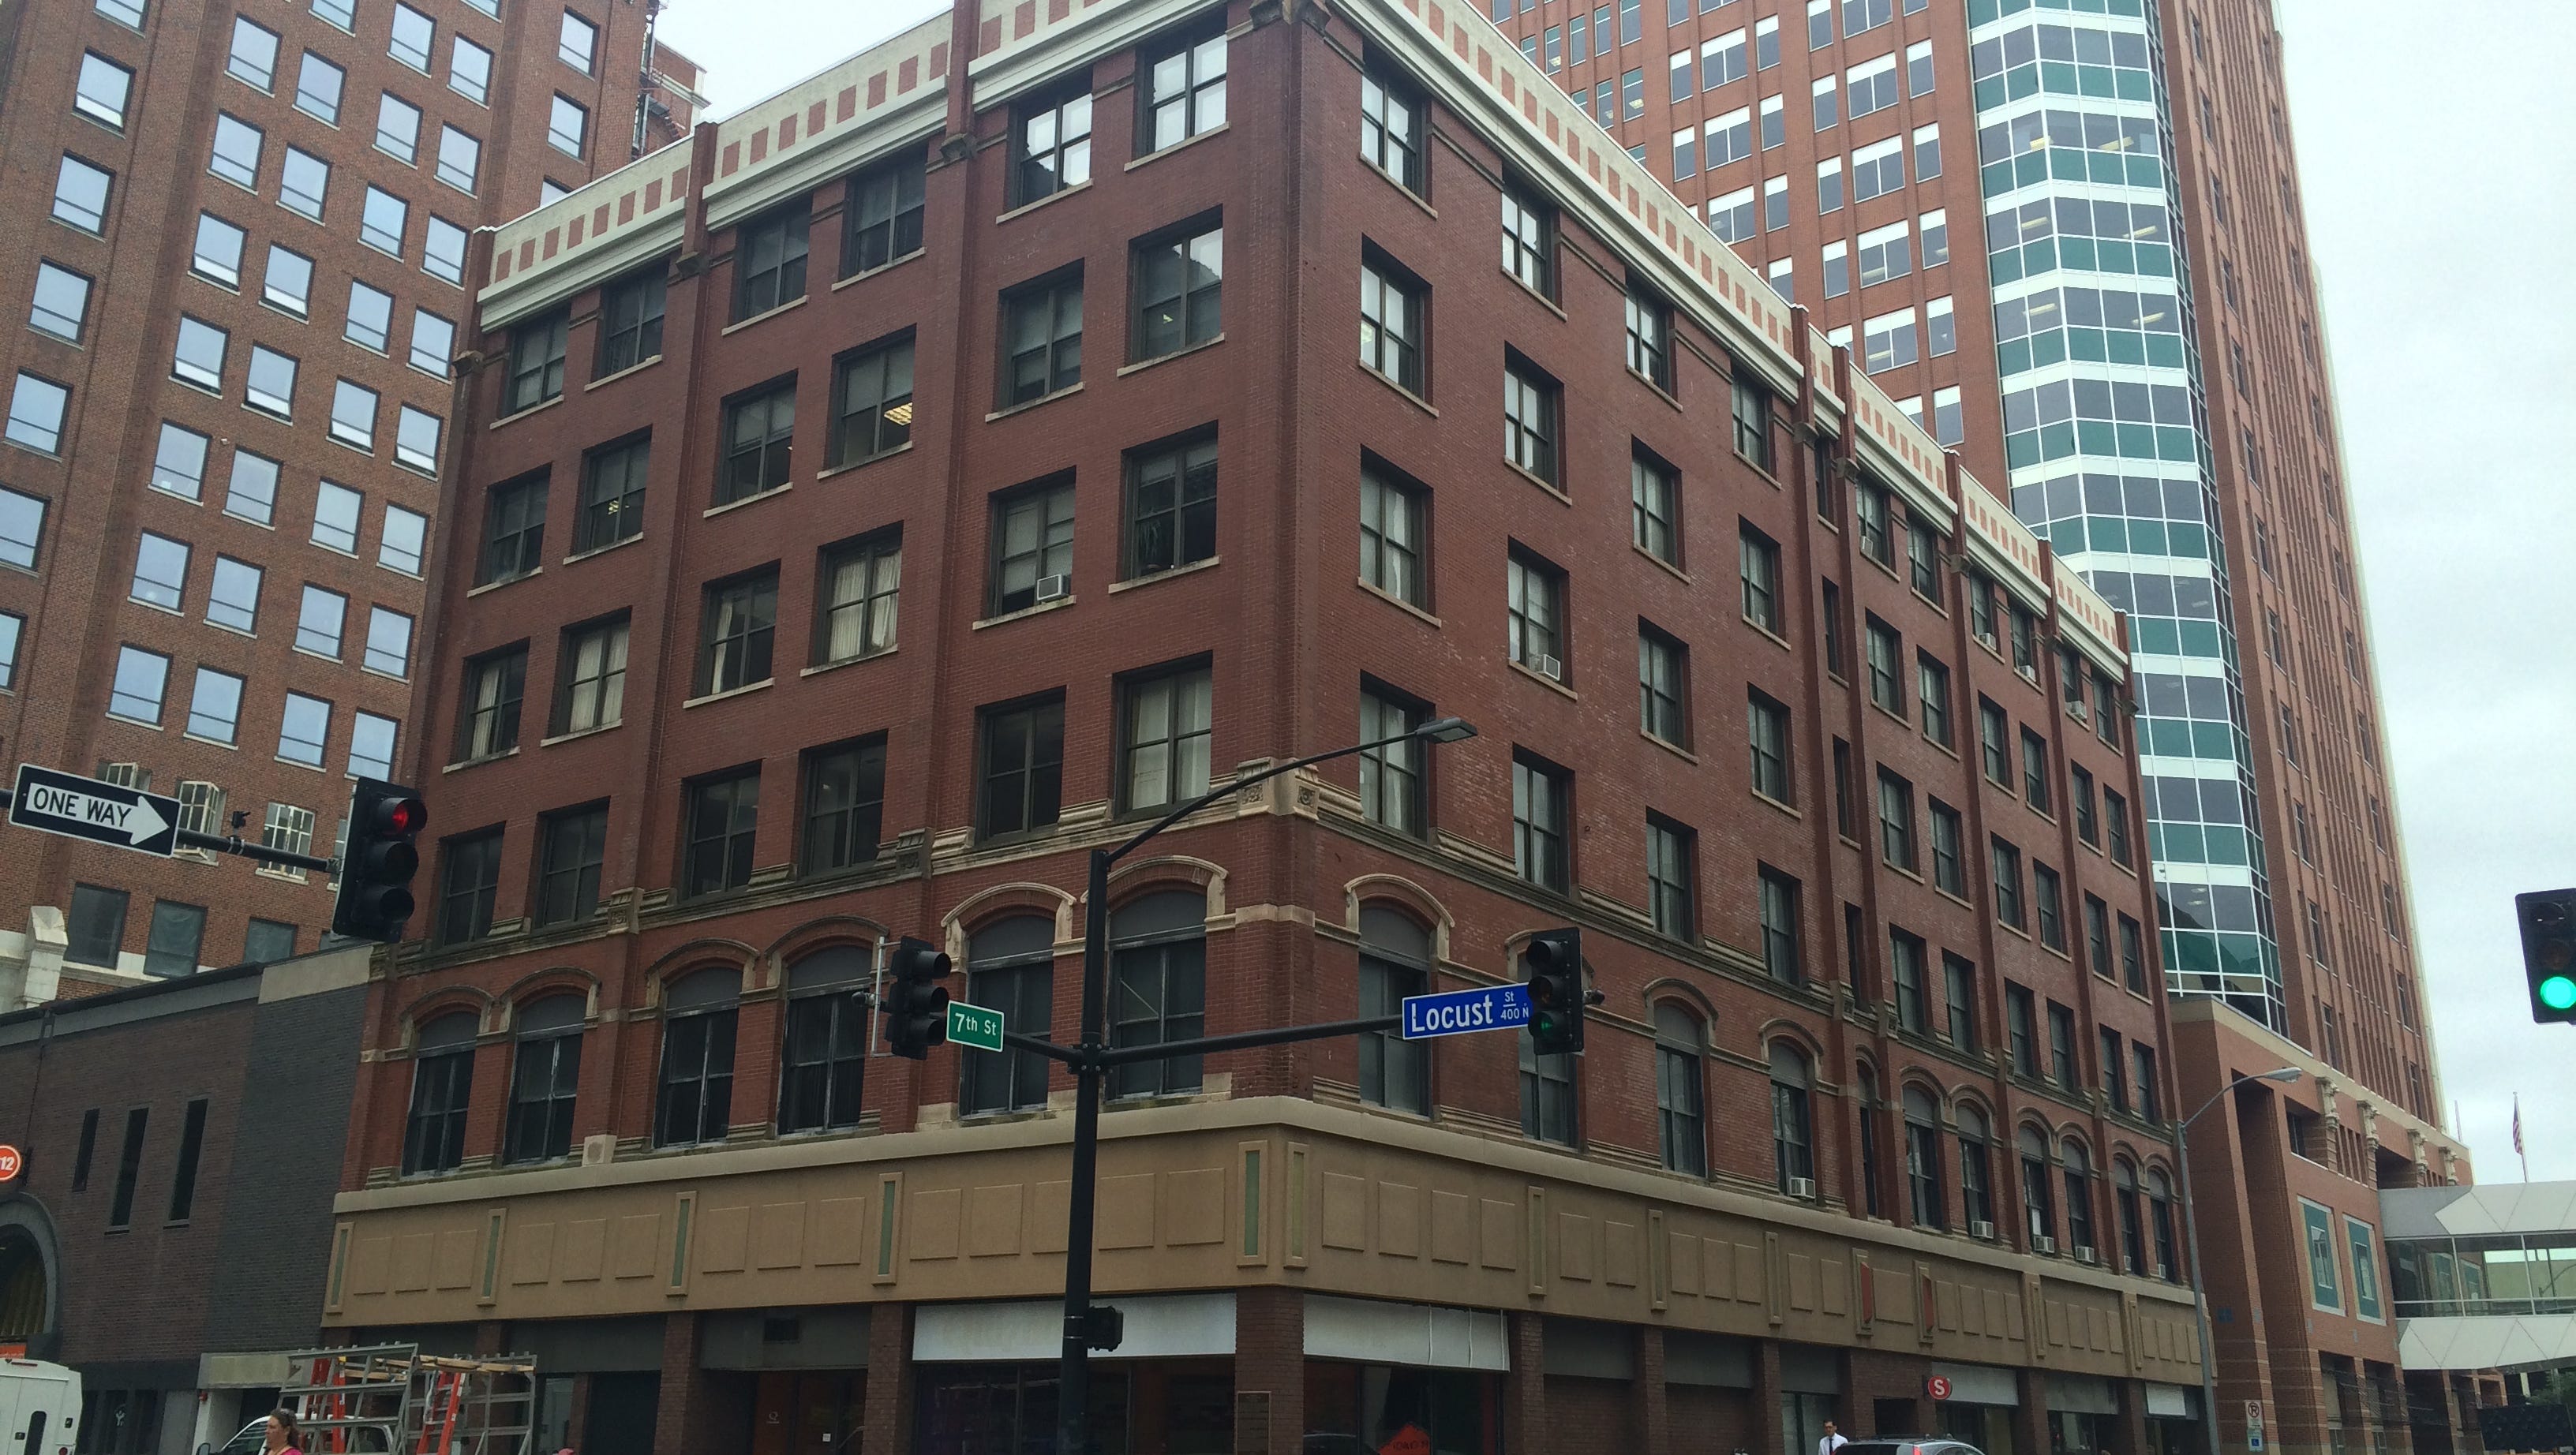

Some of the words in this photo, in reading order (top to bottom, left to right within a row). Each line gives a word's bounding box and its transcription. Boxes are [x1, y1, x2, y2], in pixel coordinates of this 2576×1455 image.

[33, 787, 80, 817] ONE
[87, 799, 132, 827] WAY
[1411, 993, 1493, 1033] Locust
[1504, 990, 1515, 1002] St
[1500, 1008, 1520, 1021] 400
[1522, 1006, 1530, 1018] N
[955, 1012, 978, 1033] 7th
[984, 1019, 997, 1036] St
[1934, 1379, 1945, 1396] S
